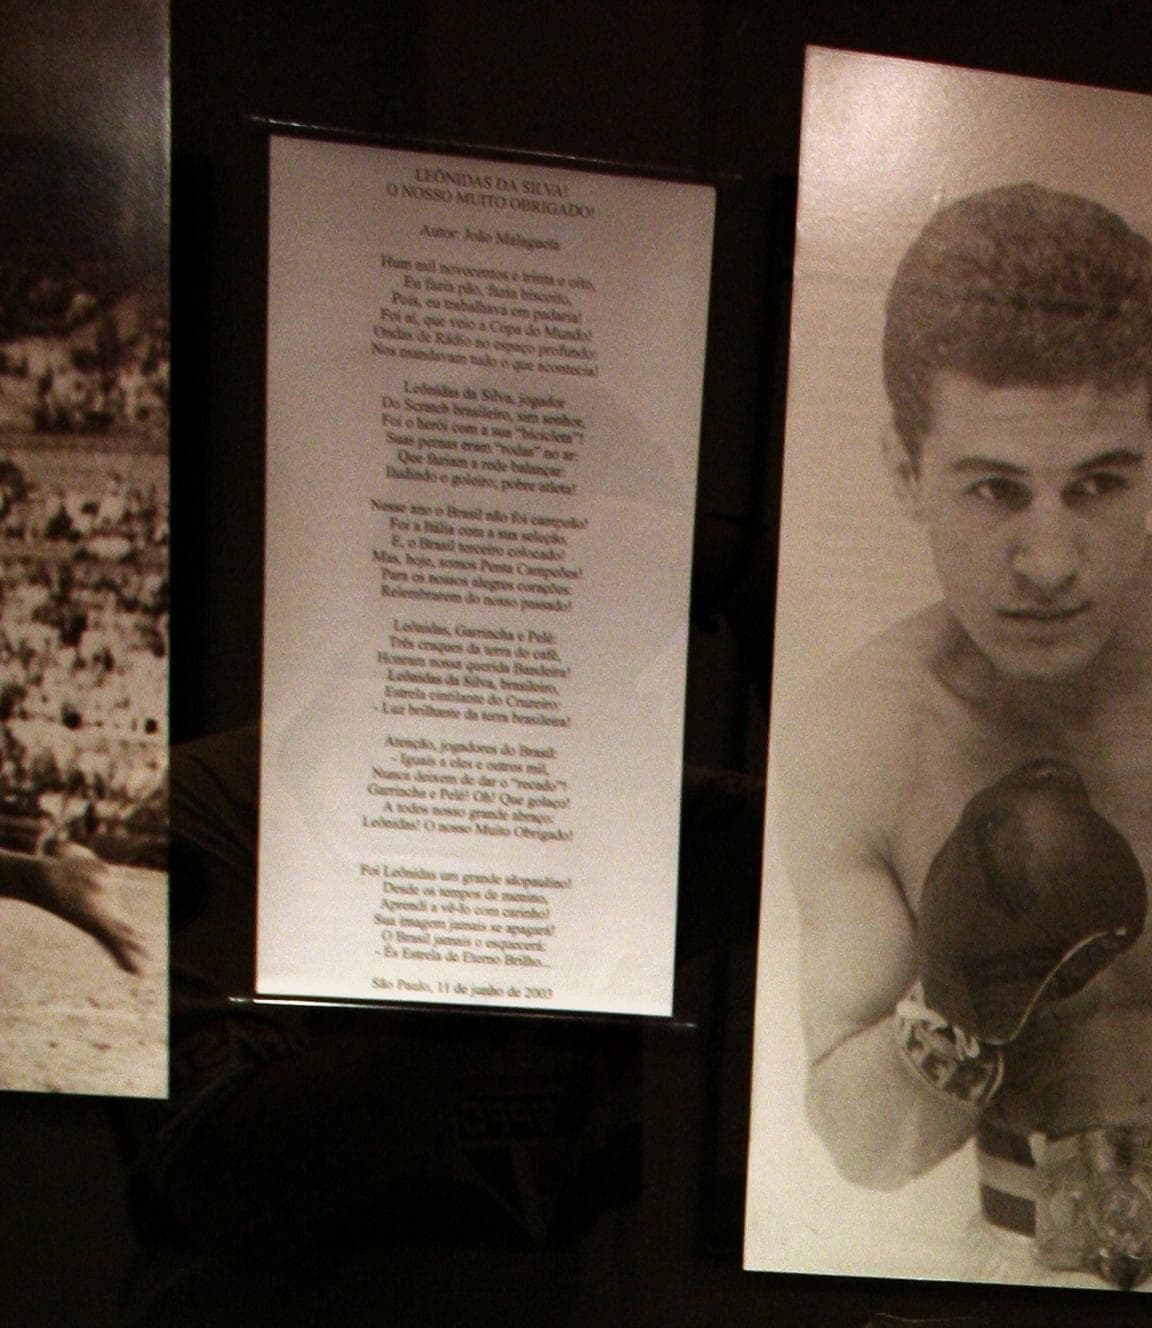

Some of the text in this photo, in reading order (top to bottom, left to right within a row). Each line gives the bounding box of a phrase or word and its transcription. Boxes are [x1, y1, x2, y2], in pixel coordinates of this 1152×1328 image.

[415, 167, 567, 198] LEÔNIDAS DA SILVA!
[386, 183, 594, 219] O NOSSO MUITO OBRIGADO!
